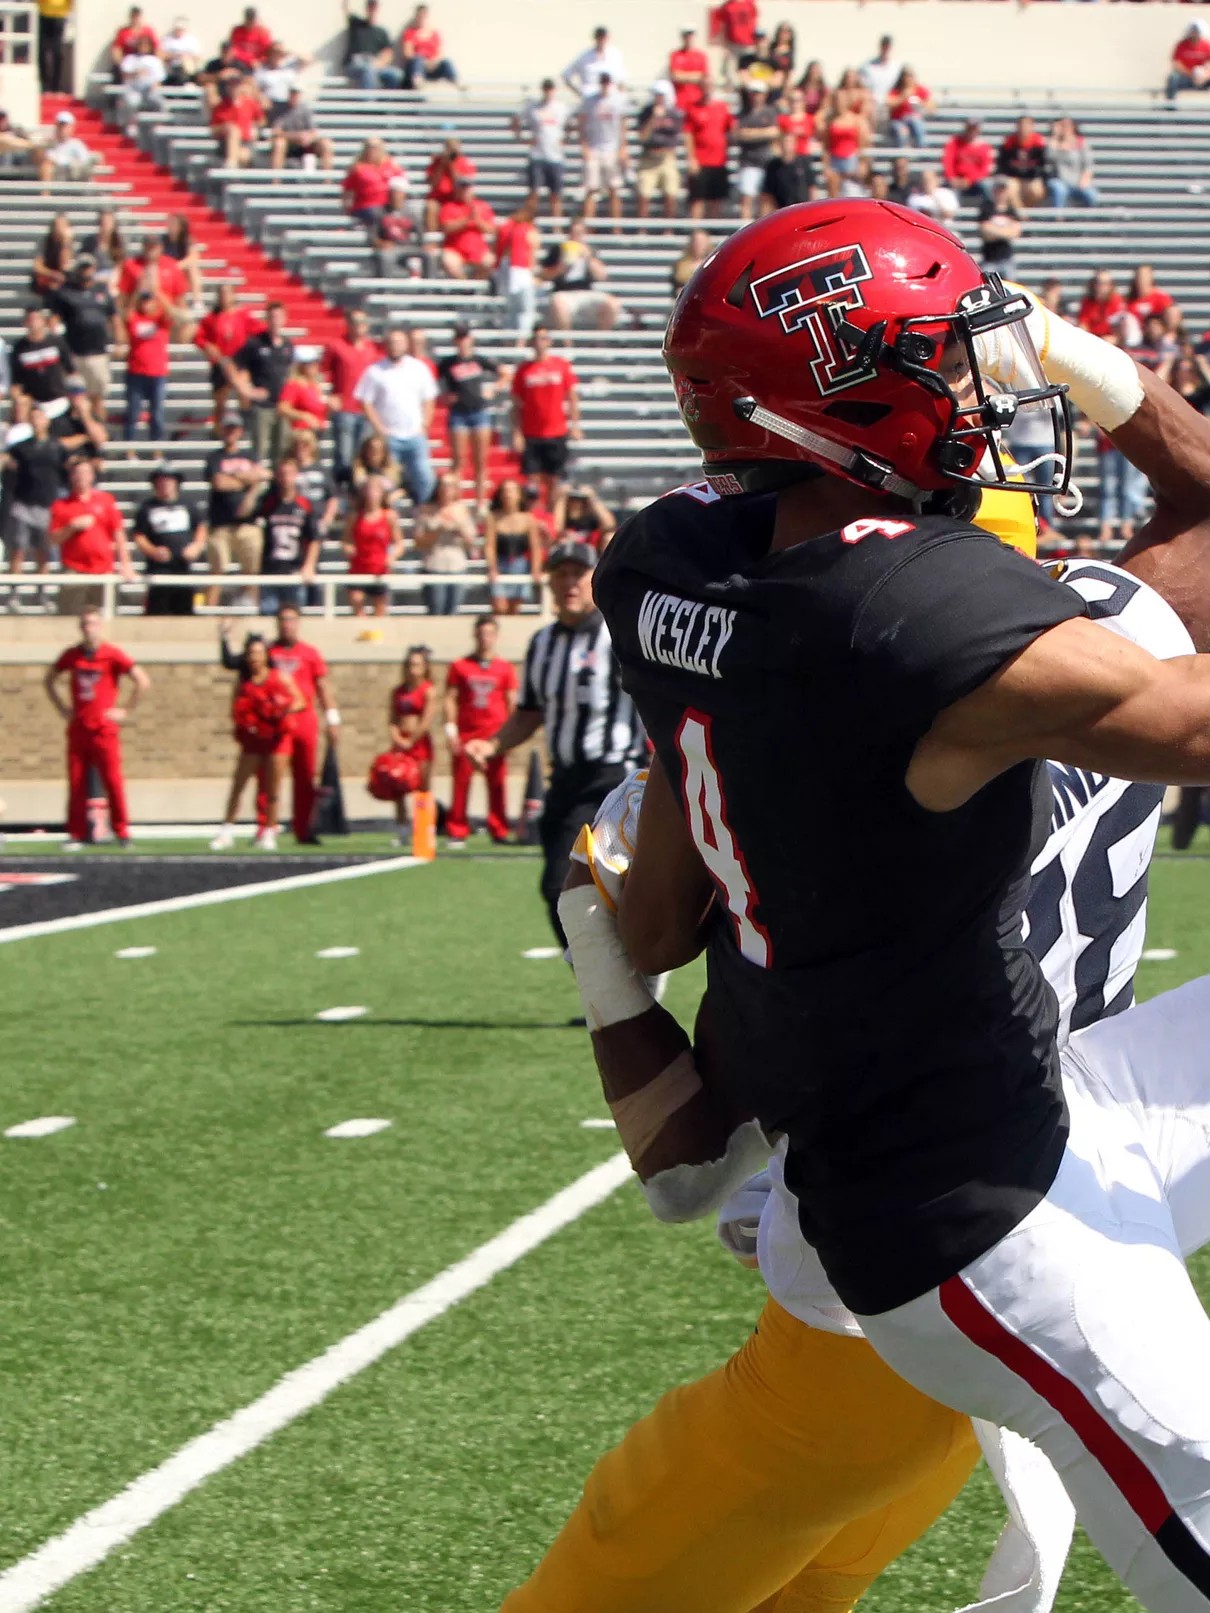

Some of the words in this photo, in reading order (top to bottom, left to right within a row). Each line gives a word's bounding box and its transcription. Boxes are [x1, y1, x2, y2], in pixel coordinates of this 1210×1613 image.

[840, 518, 917, 545] 4
[638, 590, 738, 679] WESLEY
[673, 705, 774, 970] 4
